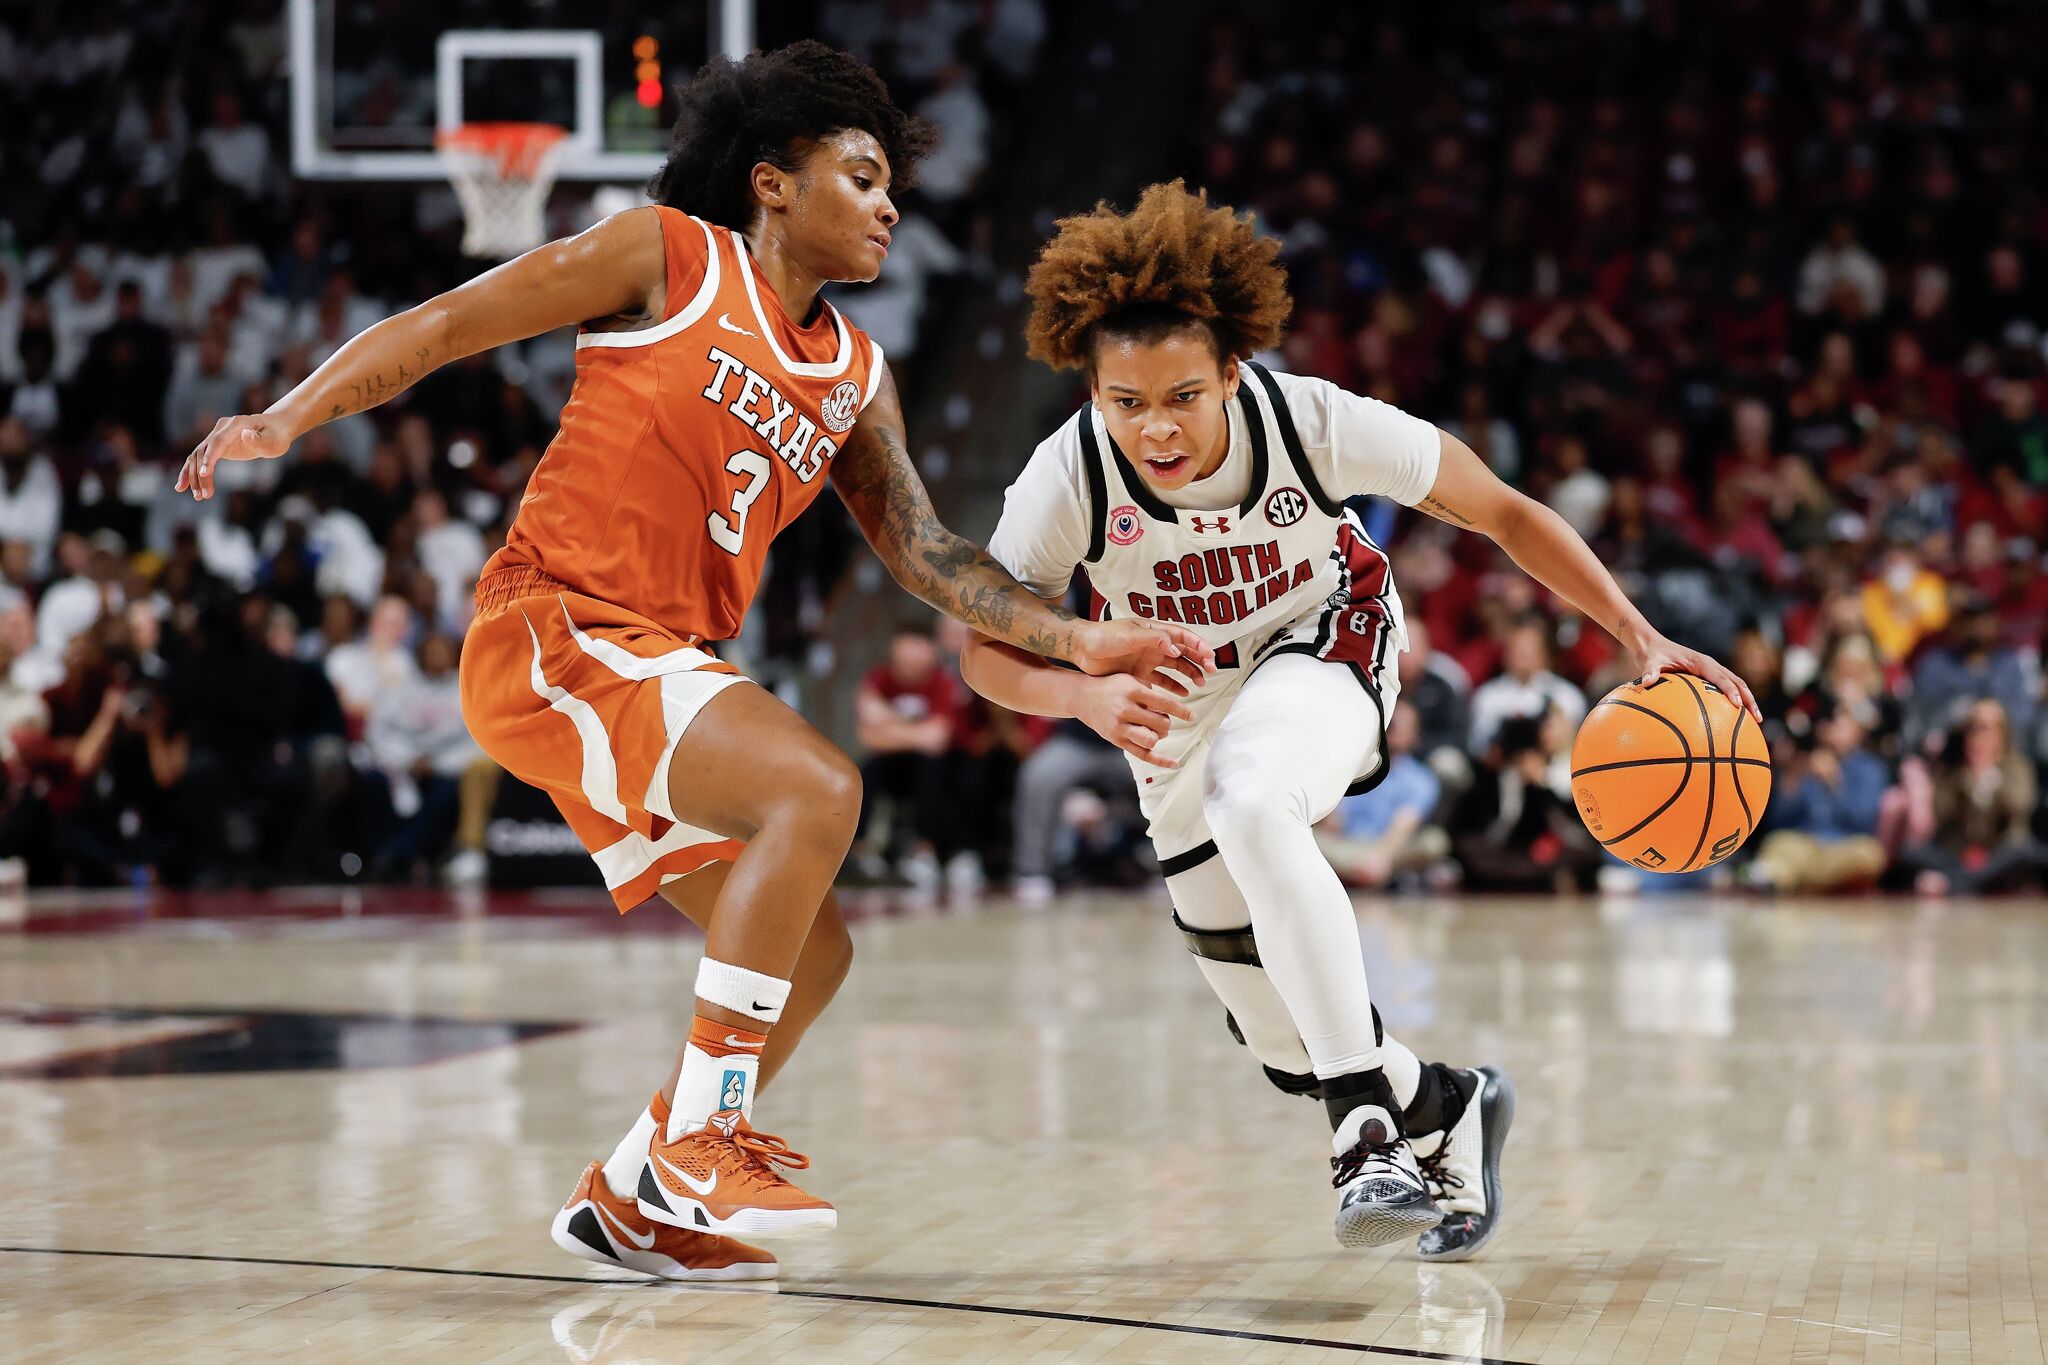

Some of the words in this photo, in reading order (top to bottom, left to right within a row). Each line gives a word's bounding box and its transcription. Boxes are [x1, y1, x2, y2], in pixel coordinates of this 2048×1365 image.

[701, 346, 838, 484] TEXAS
[829, 382, 859, 421] SEC
[707, 449, 771, 557] 3
[1267, 488, 1306, 527] SEC
[1127, 558, 1314, 625] CAROLINA
[1153, 539, 1283, 592] SOUTH
[1349, 611, 1370, 636] B
